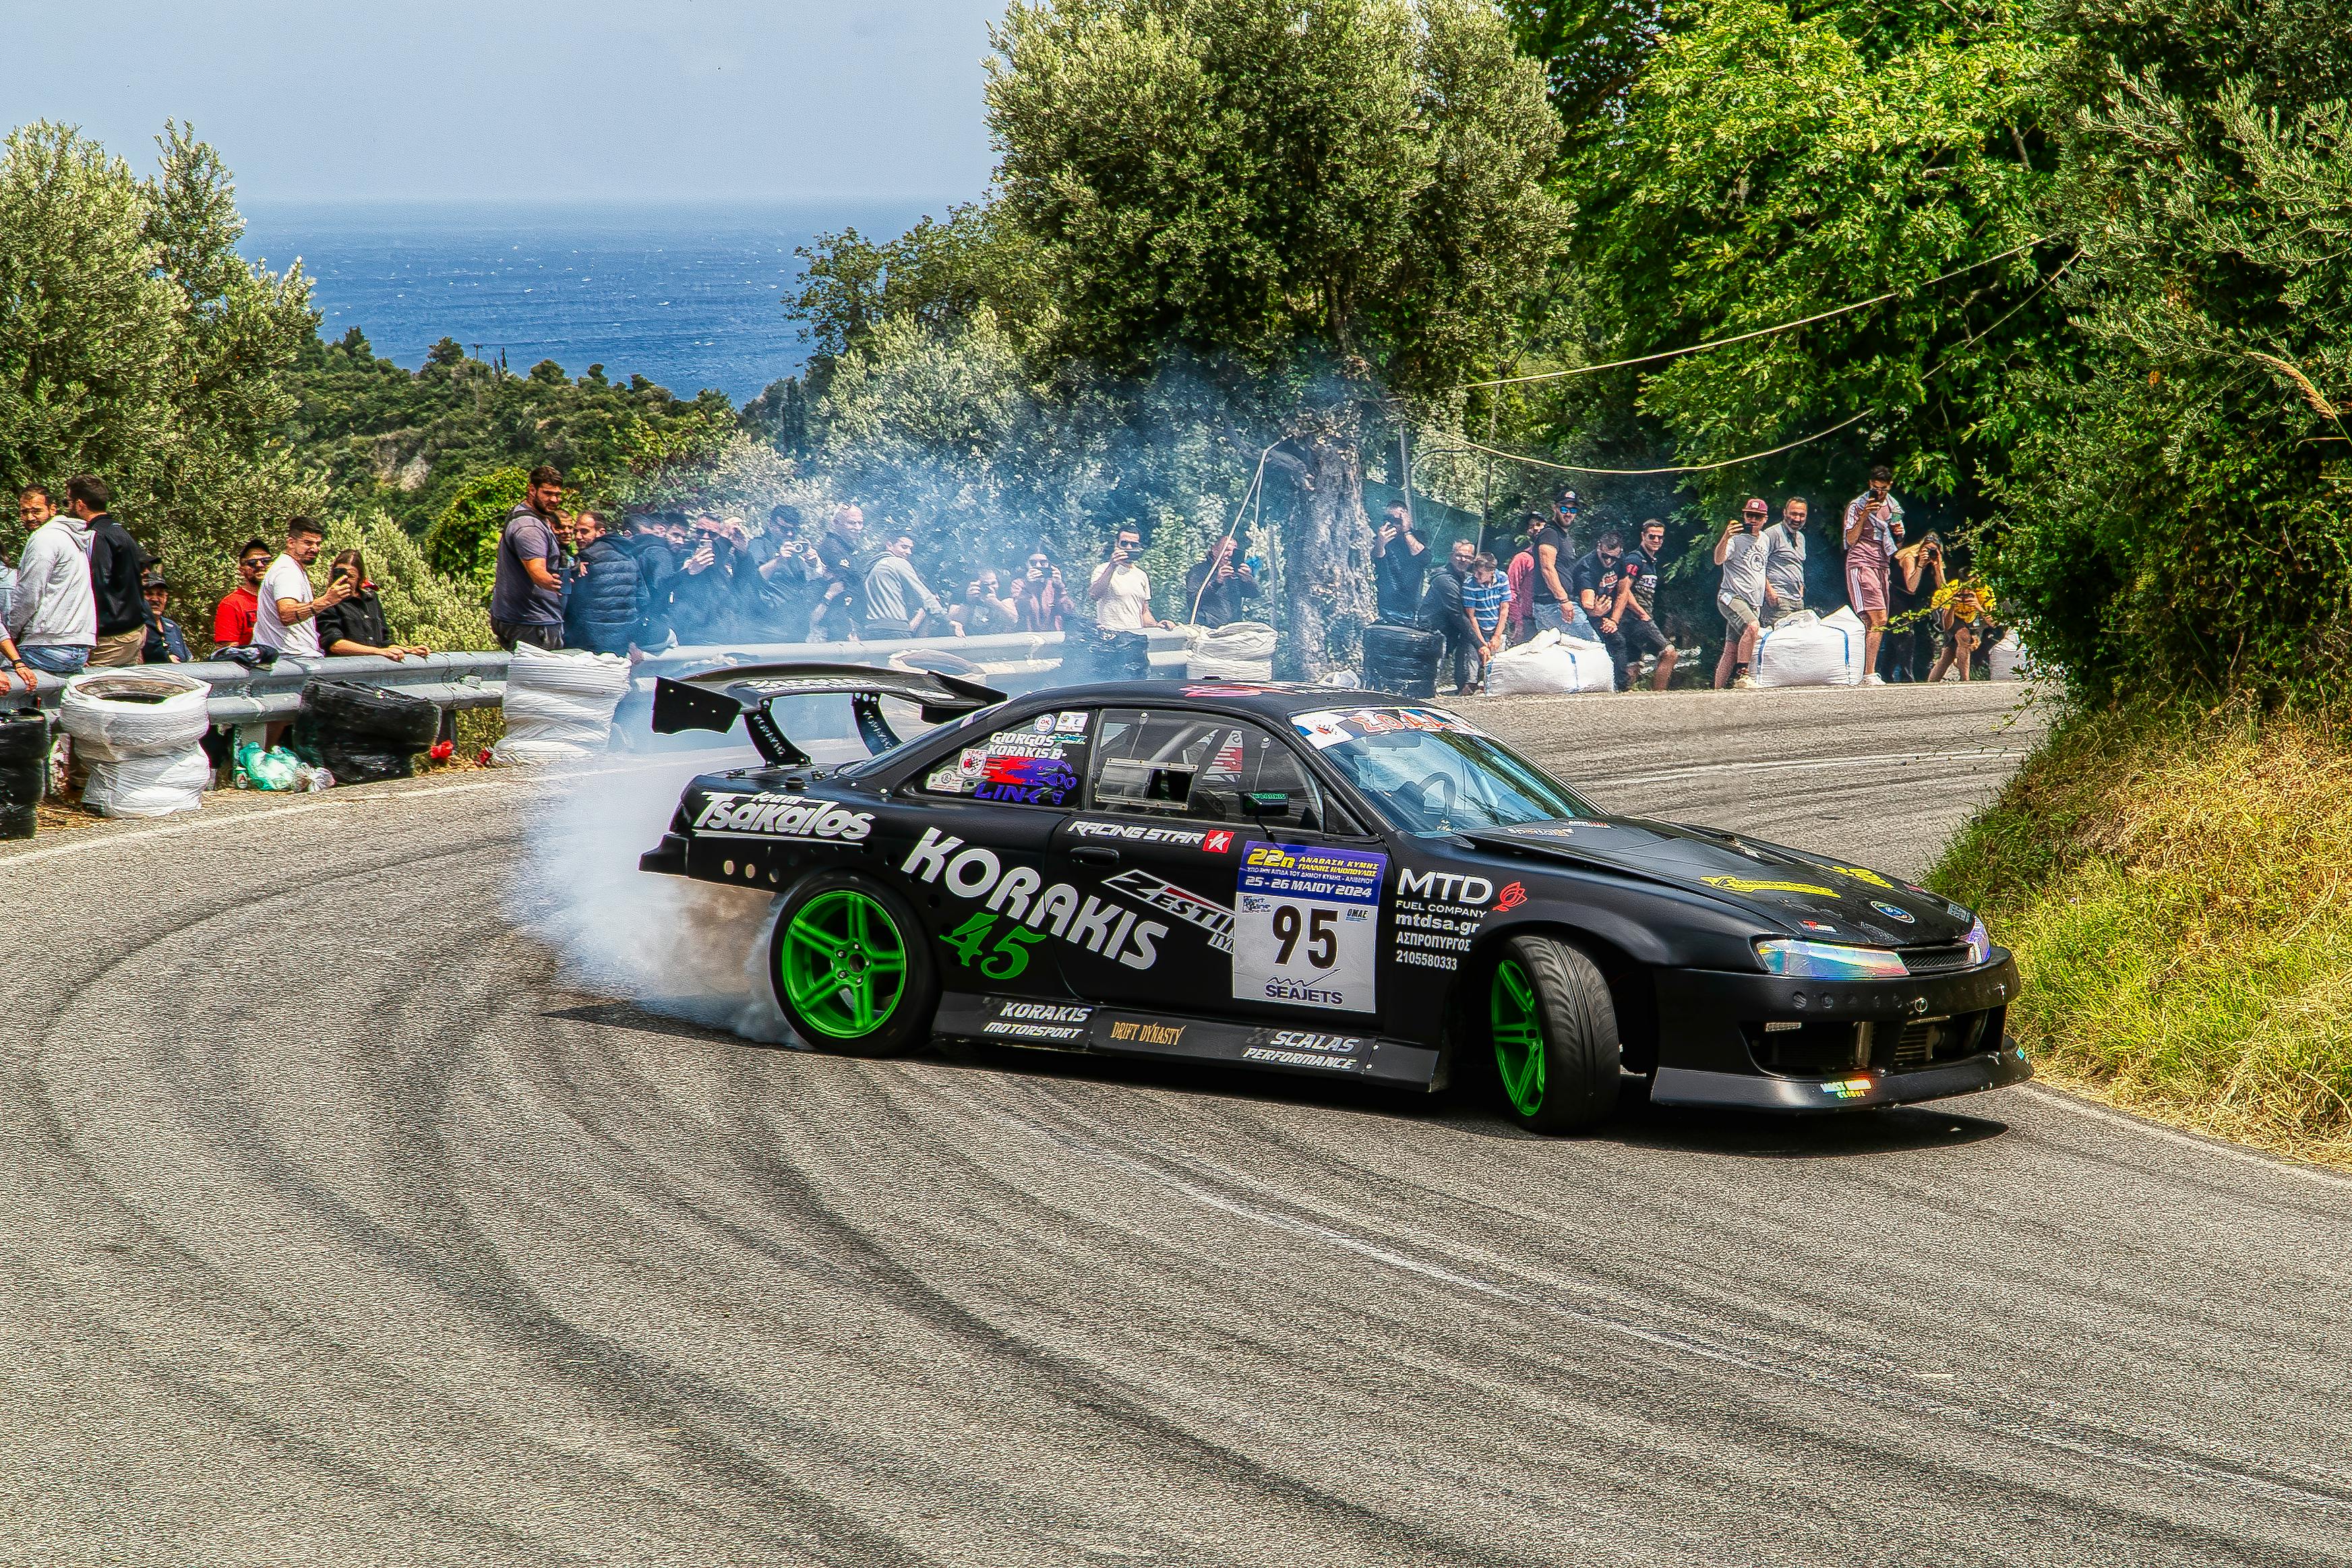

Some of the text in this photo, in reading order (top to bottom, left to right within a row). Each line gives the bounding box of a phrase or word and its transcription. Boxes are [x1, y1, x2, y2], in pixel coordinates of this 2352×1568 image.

[990, 731, 1056, 747] GIORGOS
[988, 744, 1052, 758] KORAKIS
[752, 791, 804, 805] team
[1067, 820, 1205, 845] RACING STAR
[1347, 860, 1379, 870] ΚΥΜΗΣ
[1245, 876, 1265, 886] 25
[1271, 878, 1290, 889] 26
[1335, 884, 1373, 898] 2024
[1397, 868, 1494, 904] MTD
[901, 826, 1169, 969] KORAKIS
[1395, 900, 1487, 918] FUEL COMPANY
[1395, 913, 1480, 935] mtdsa.gr
[939, 913, 1046, 979] 45
[1272, 904, 1339, 969] 95
[1396, 931, 1472, 952] ΑΣΠΡΟΠΥΡΓΟΣ
[1396, 950, 1457, 971] 2105580333
[1264, 984, 1344, 1005] SEAJETS
[999, 1002, 1093, 1022] KORAKIS
[983, 1021, 1084, 1039] MOTORSPORT
[1110, 1021, 1186, 1046] DRIFT DYNASTY
[1269, 1031, 1360, 1052] SCALAS
[1242, 1047, 1358, 1069] PERFORMANCE
